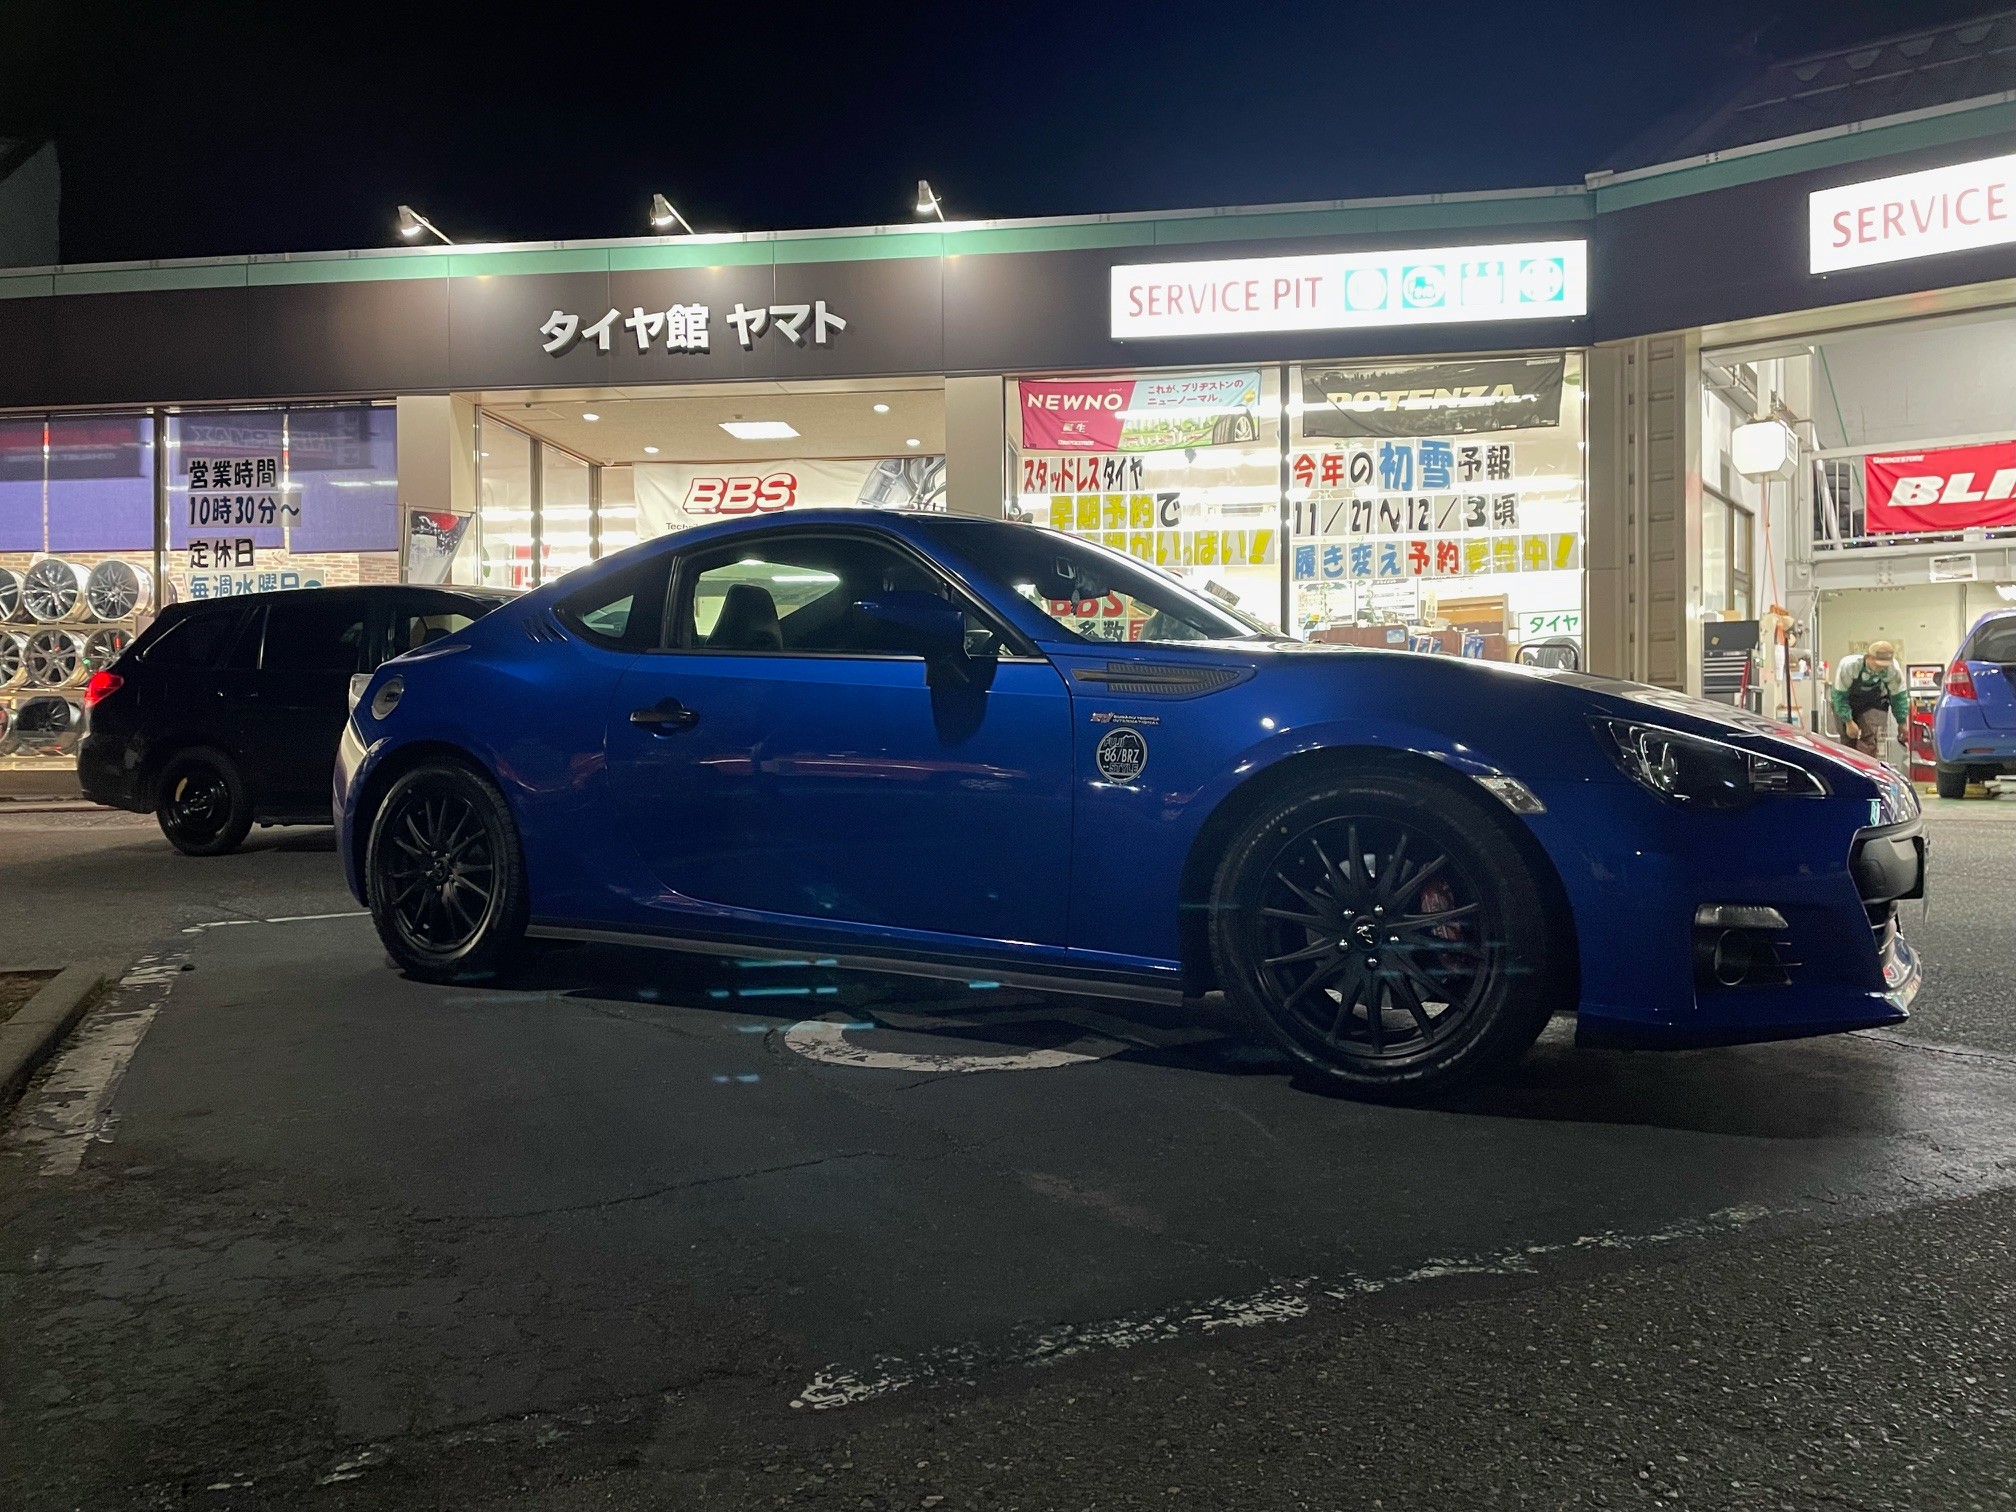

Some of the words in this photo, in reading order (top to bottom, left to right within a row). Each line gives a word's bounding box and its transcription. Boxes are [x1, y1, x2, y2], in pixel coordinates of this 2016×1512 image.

[1832, 183, 2008, 249] SERVICE
[1129, 279, 1260, 318] SERVICE
[1273, 277, 1324, 310] PIT
[540, 303, 710, 353] タイヤ館
[726, 300, 847, 350] ヤマト
[1027, 393, 1123, 411] NEWNO
[189, 460, 277, 488] 営業時間
[1024, 457, 1143, 493] スタッドレスタイヤ
[1293, 440, 1512, 491] 今年の初雪予報
[682, 472, 798, 515] BBS
[1887, 467, 2016, 507] BLI
[1050, 492, 1180, 529] 早期予約で
[189, 538, 254, 568] 定休日
[1529, 614, 1580, 634] タイヤ
[1103, 748, 1140, 763] 86/BRZ
[1109, 763, 1139, 773] STYLE
